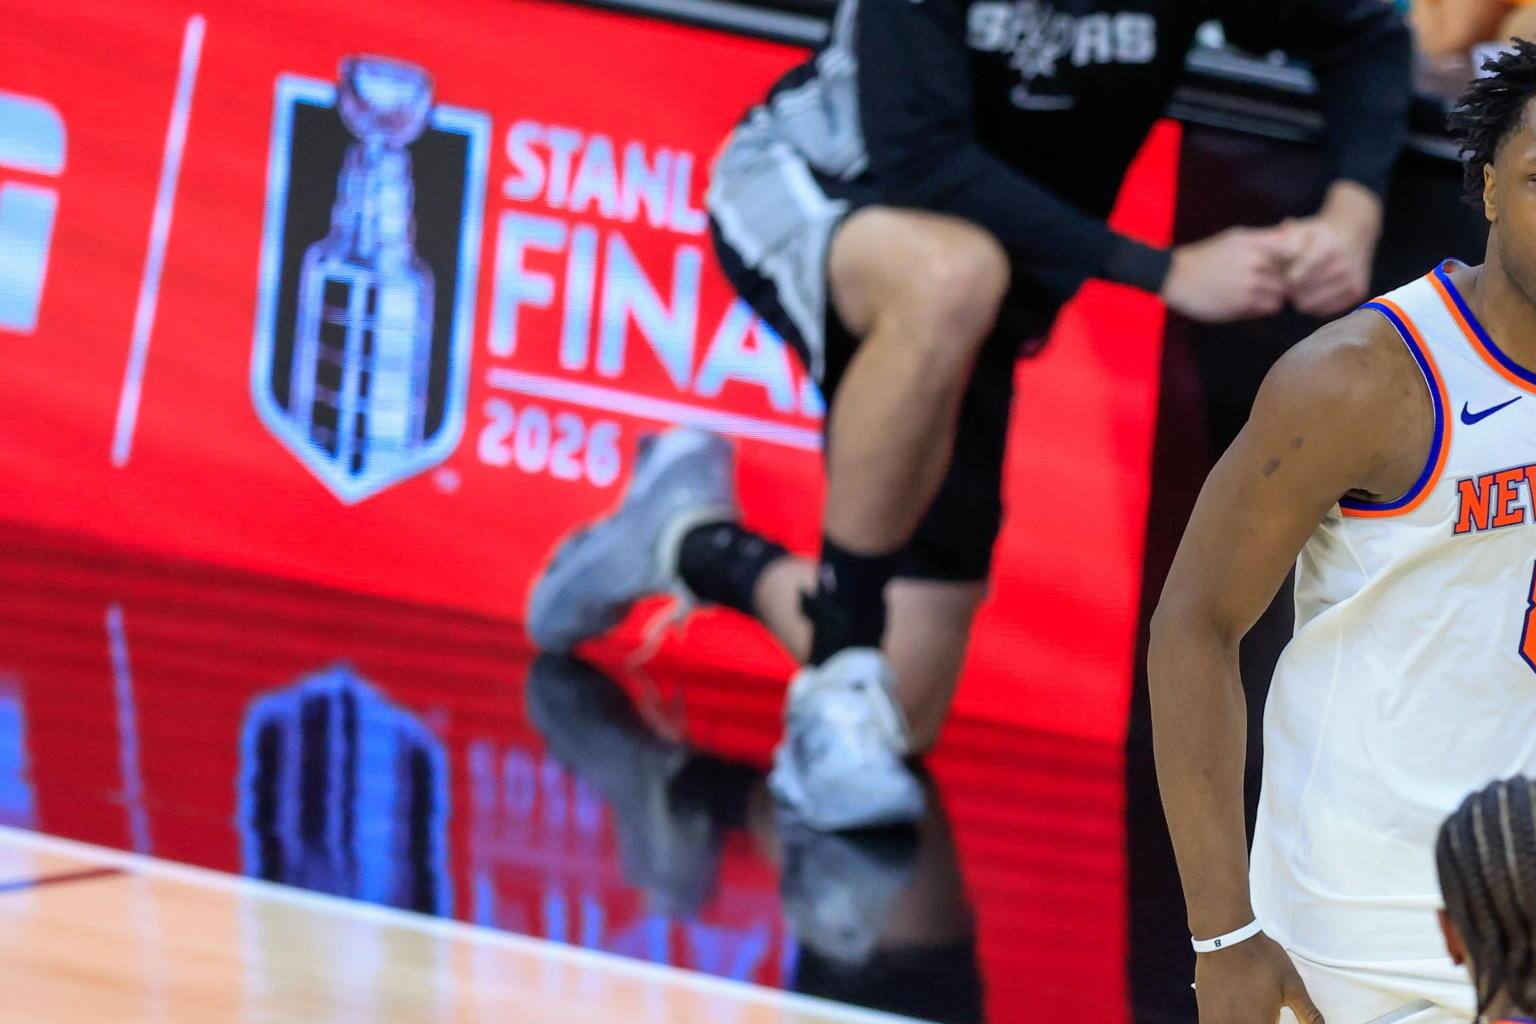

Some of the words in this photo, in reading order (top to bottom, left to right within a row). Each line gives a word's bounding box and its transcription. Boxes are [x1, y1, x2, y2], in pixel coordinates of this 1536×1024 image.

[503, 119, 709, 236] STANL
[488, 208, 827, 411] FINA
[477, 397, 621, 488] 2026
